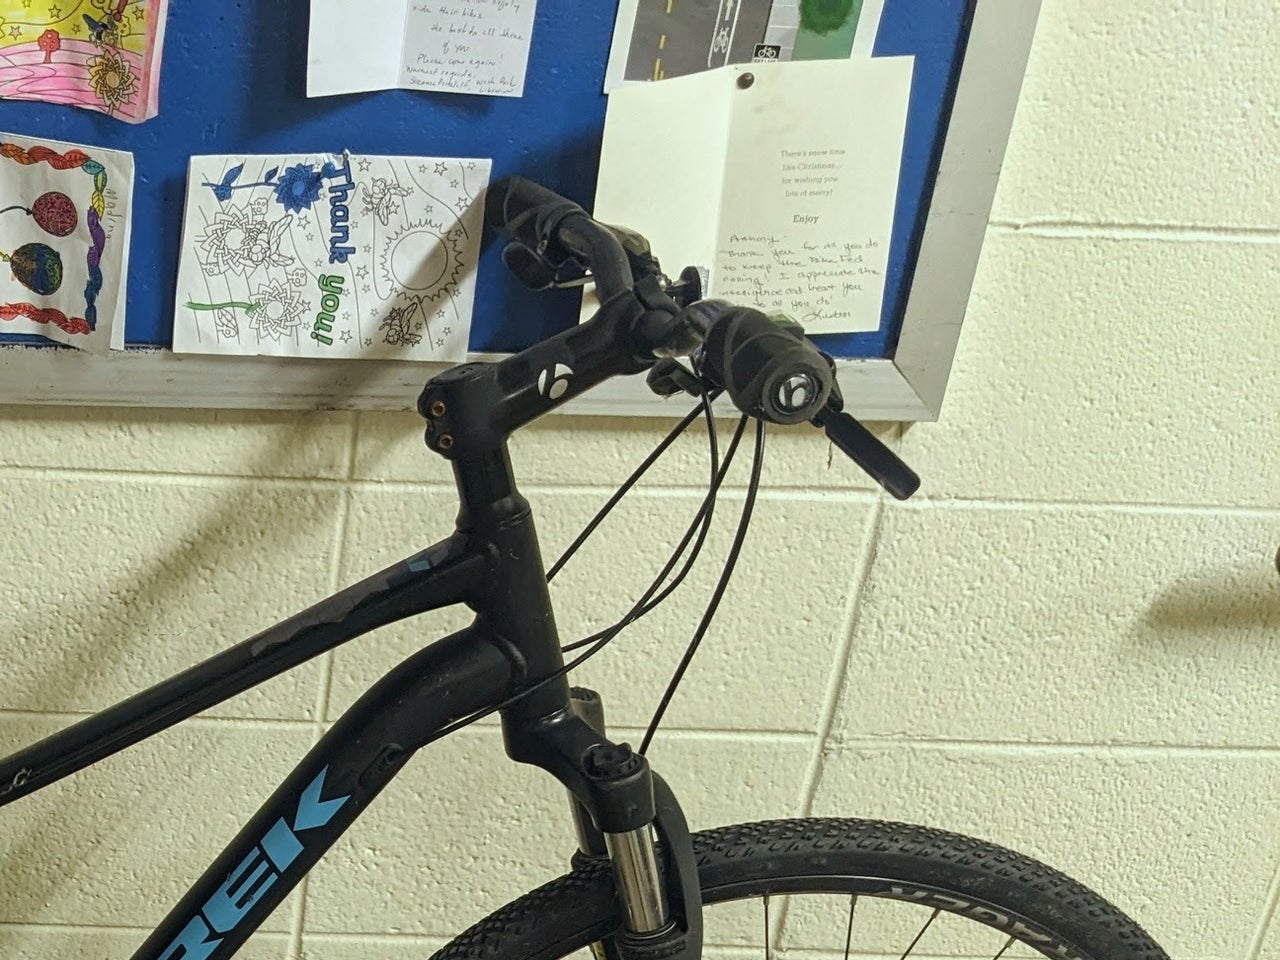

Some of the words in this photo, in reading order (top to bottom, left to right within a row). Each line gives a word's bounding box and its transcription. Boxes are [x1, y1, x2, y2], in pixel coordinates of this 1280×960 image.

[328, 158, 357, 265] Thank
[793, 213, 820, 225] Enjoy
[865, 237, 879, 249] do
[311, 273, 345, 346] you!
